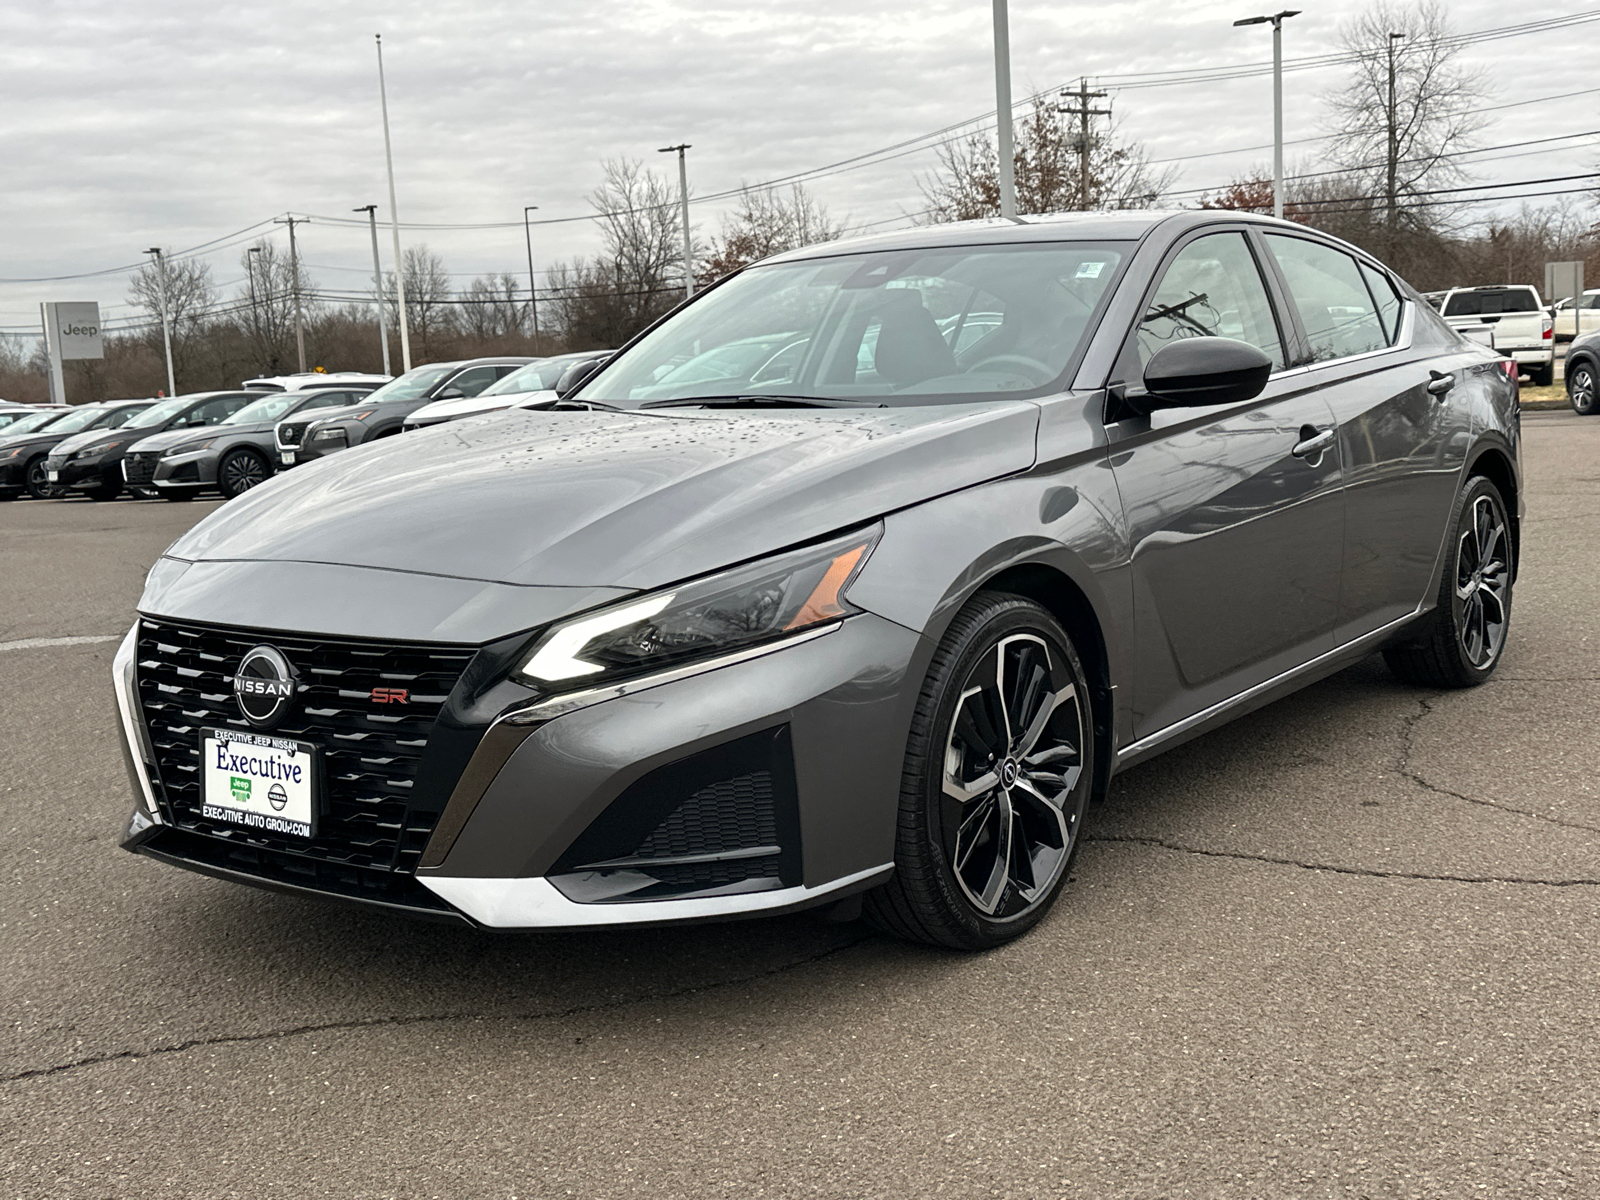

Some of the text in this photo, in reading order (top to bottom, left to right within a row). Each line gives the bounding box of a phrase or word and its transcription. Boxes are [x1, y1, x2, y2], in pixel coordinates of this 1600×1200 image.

[63, 323, 97, 337] Jeep
[234, 678, 291, 696] NISSAN
[371, 687, 408, 704] SR
[214, 730, 298, 751] EXECUTIVE JEEP NISSAN
[216, 744, 302, 784] Executive
[232, 778, 250, 790] Jeep
[202, 805, 310, 837] EXECUTIVE AUTO GROUP.COM
